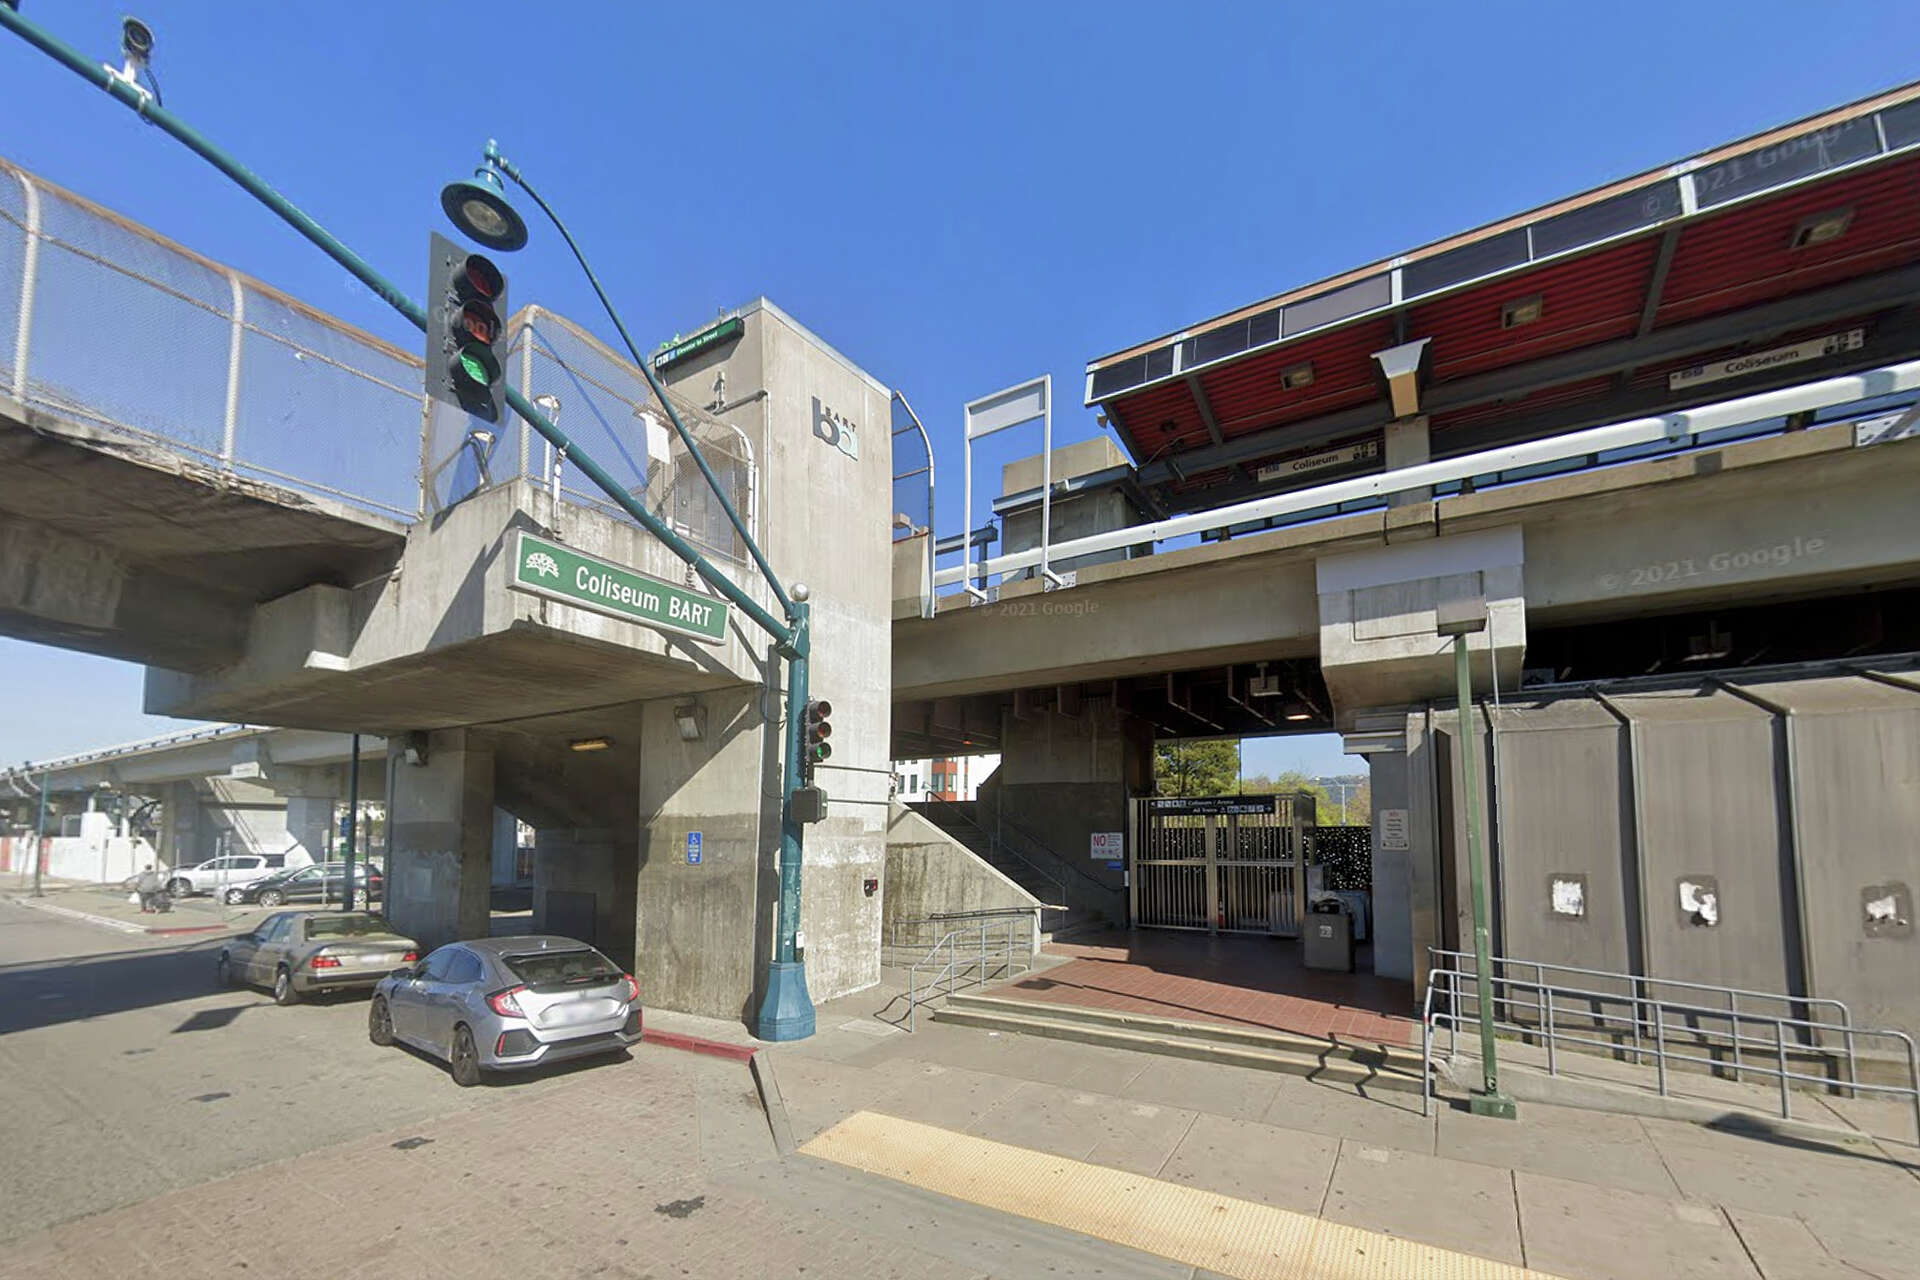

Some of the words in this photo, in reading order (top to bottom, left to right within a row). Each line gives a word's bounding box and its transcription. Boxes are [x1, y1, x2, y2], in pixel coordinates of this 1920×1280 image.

[1725, 350, 1799, 374] Coliseum
[825, 406, 856, 432] BART
[1292, 453, 1339, 471] Coliseum
[575, 566, 660, 613] Coliseum
[669, 596, 712, 627] BART
[1093, 835, 1106, 847] NO
